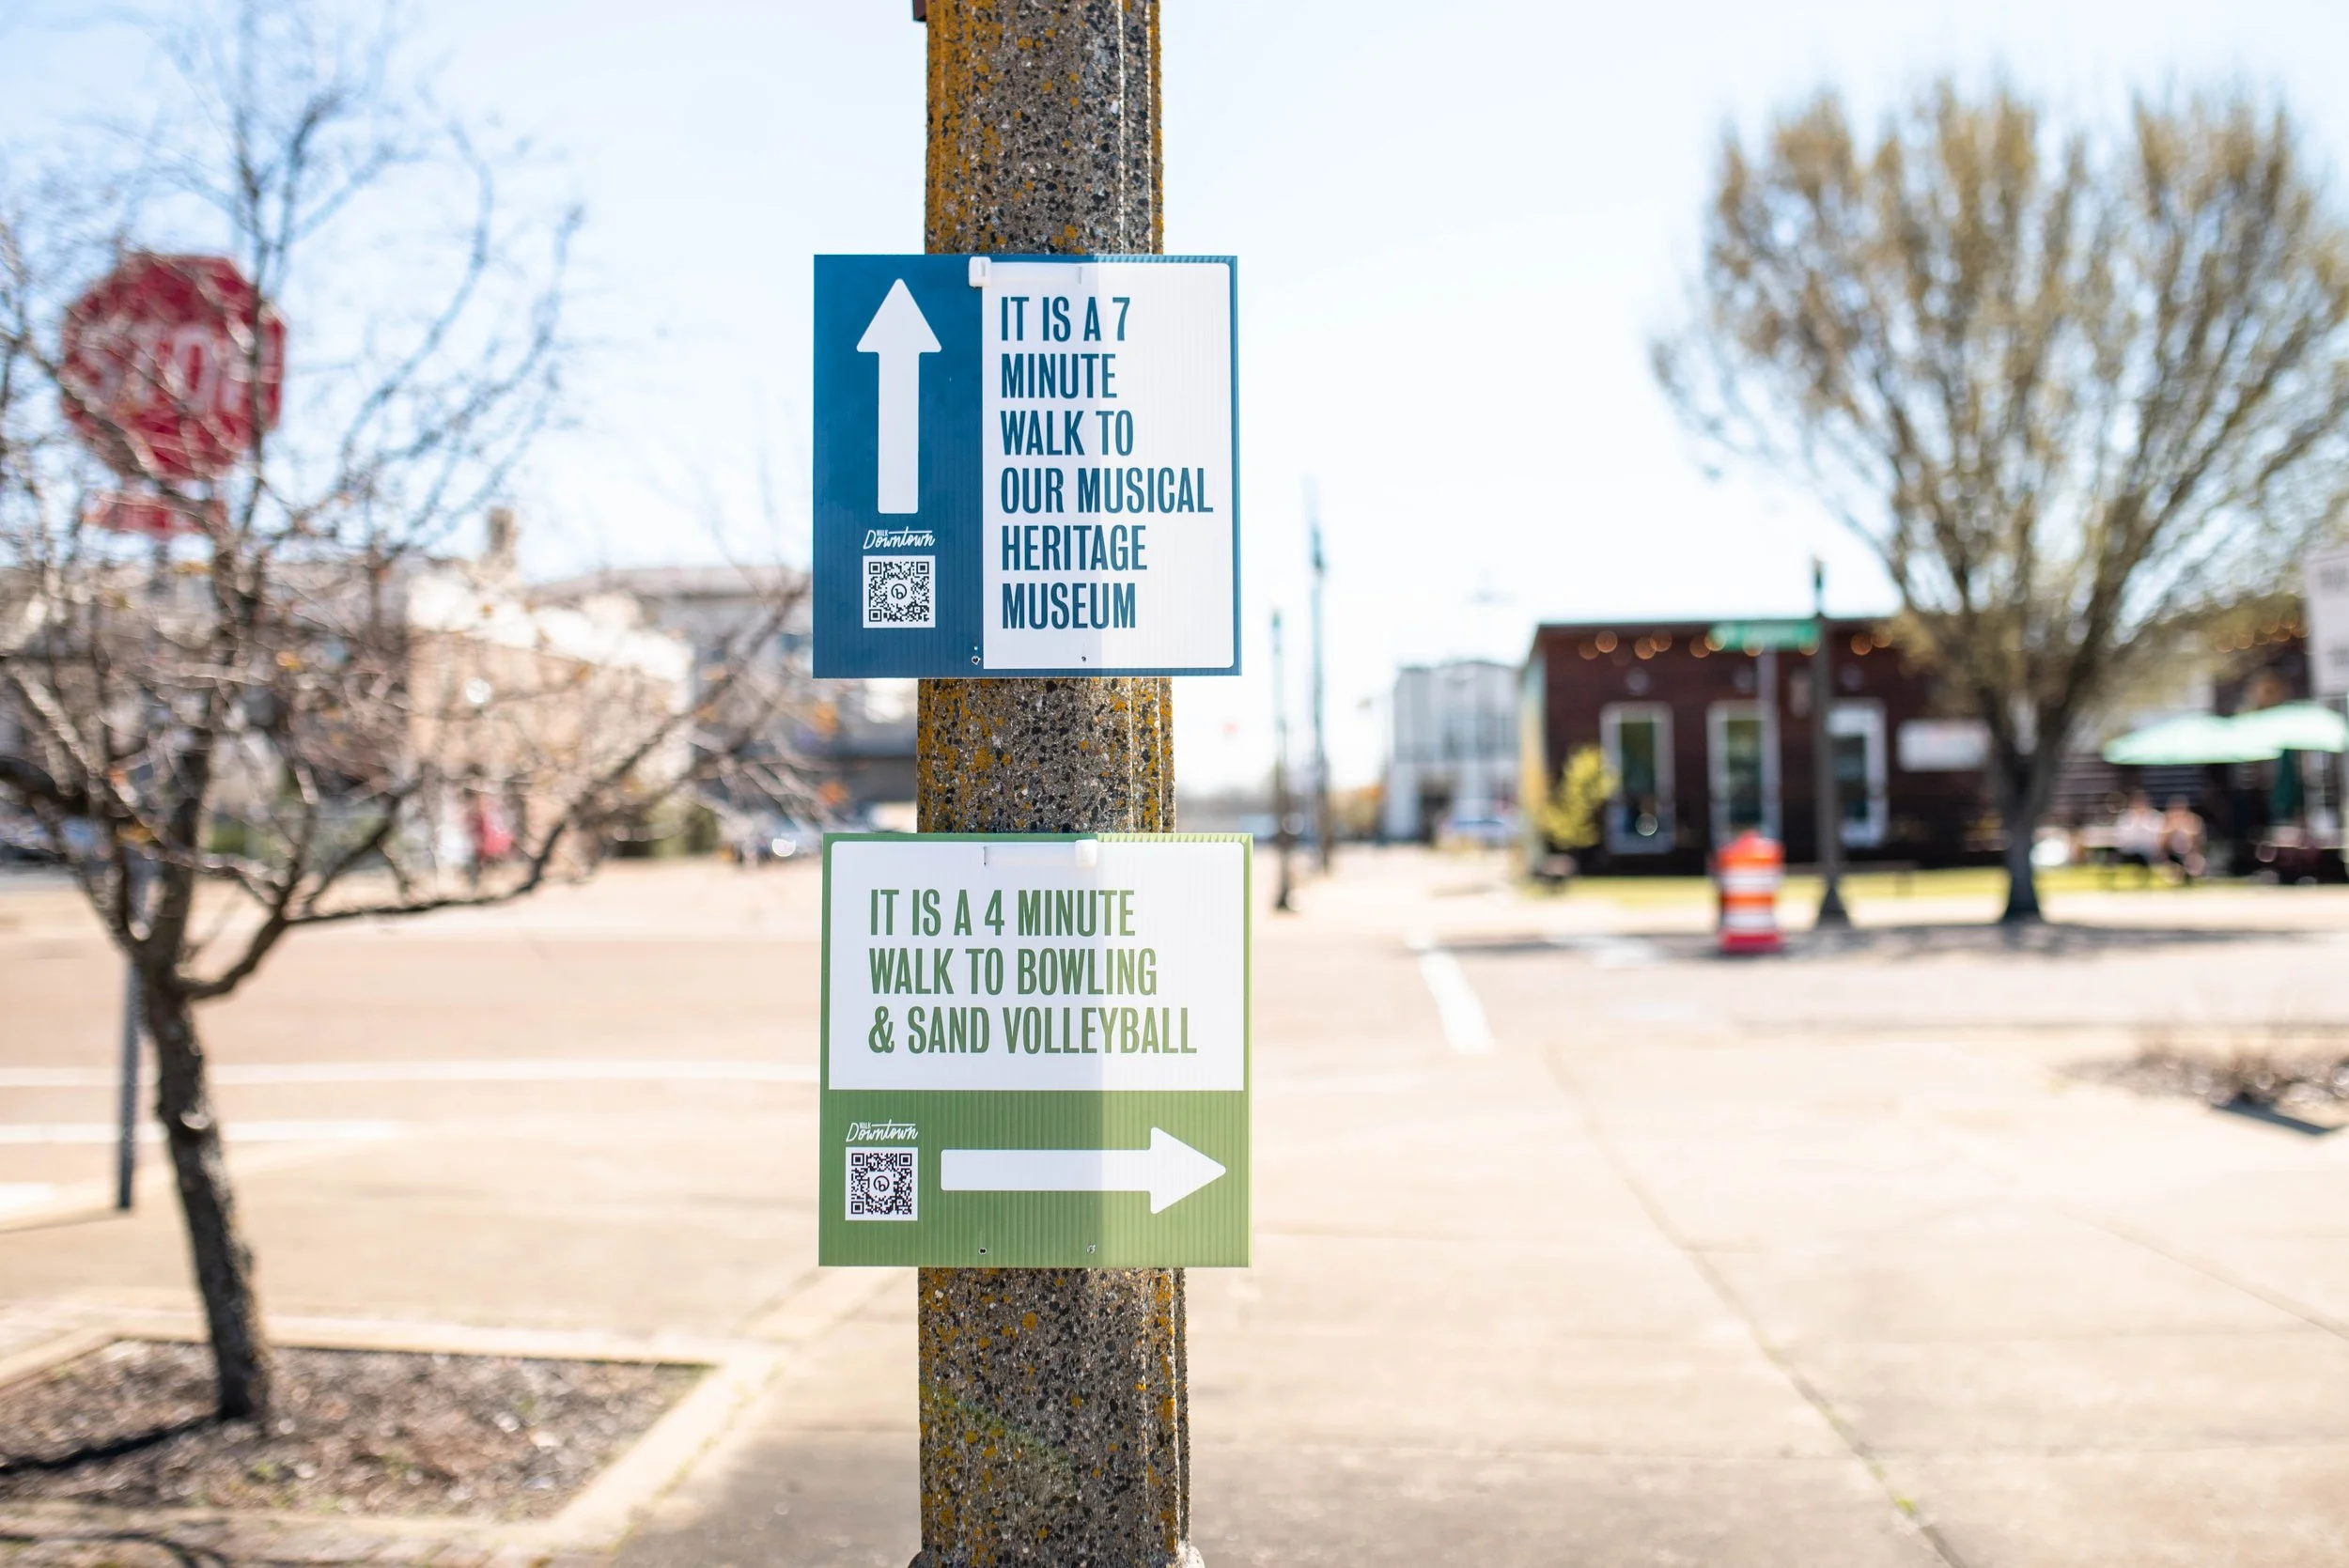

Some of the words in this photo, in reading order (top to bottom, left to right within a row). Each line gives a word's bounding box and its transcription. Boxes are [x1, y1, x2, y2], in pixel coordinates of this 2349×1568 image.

[1001, 296, 1030, 342] IT
[1042, 295, 1071, 343] IS
[1082, 296, 1102, 342] A
[1112, 296, 1131, 342] 7
[1001, 353, 1118, 399] MINUTE
[1000, 410, 1085, 457] WALK
[1095, 410, 1134, 457] TO
[1001, 467, 1065, 514] OUR
[1077, 467, 1215, 515] MUSICAL
[863, 525, 936, 550] Downtown
[1001, 524, 1148, 572] HERITAGE
[1002, 582, 1137, 630] MUSEUM
[870, 889, 899, 936] IT
[911, 889, 941, 937] IS
[954, 889, 972, 936] A
[985, 889, 1004, 936] 4
[1018, 889, 1135, 937] MINUTE
[869, 948, 954, 995] WALK
[965, 948, 1004, 995] TO
[1018, 948, 1157, 996] BOWLING
[868, 1005, 895, 1054] &
[908, 1005, 990, 1054] SAND
[1003, 1007, 1198, 1055] VOLLEYBALL
[846, 1118, 919, 1142] Downtown
